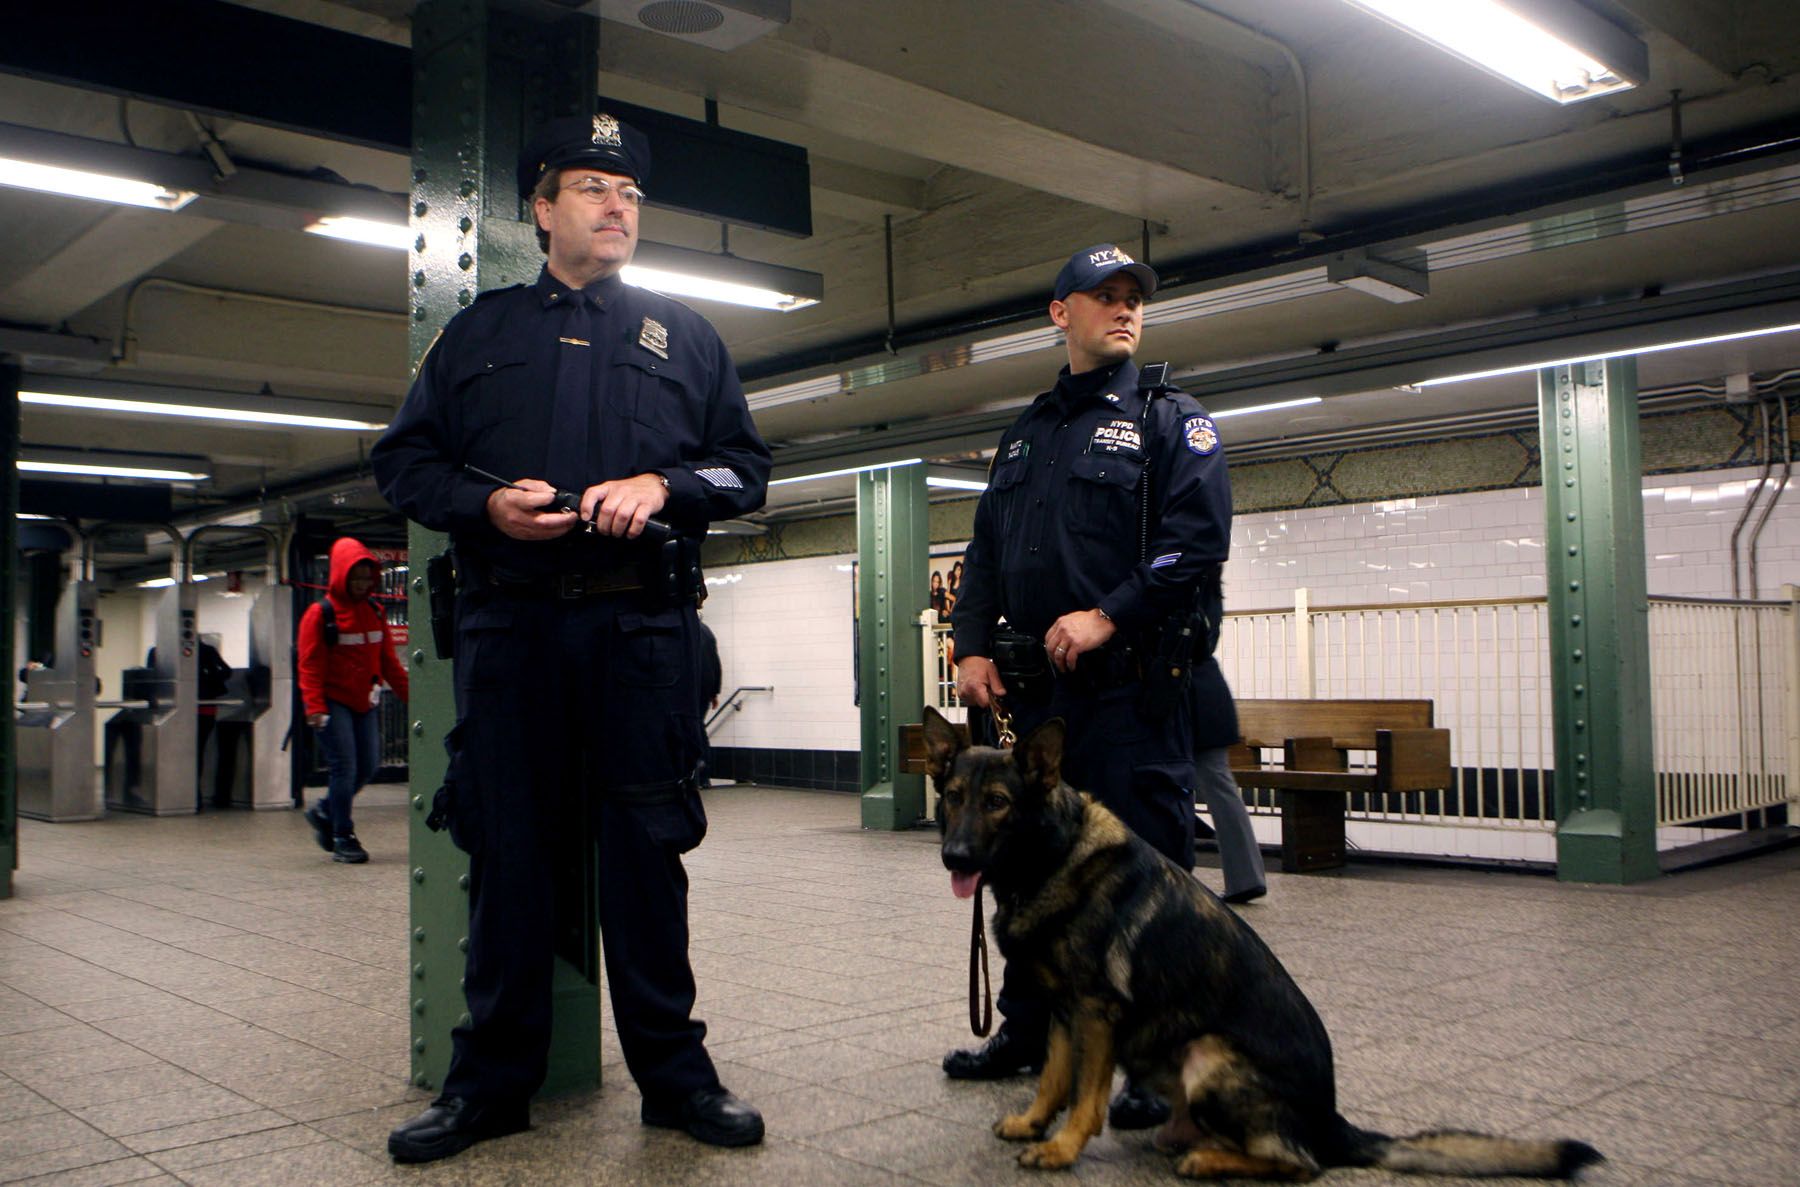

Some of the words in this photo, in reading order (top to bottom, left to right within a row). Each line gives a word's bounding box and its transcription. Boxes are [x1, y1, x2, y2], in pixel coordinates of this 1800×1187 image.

[1110, 420, 1134, 430] NYPD
[1185, 418, 1212, 430] NYPD
[1094, 427, 1141, 446] POLICE
